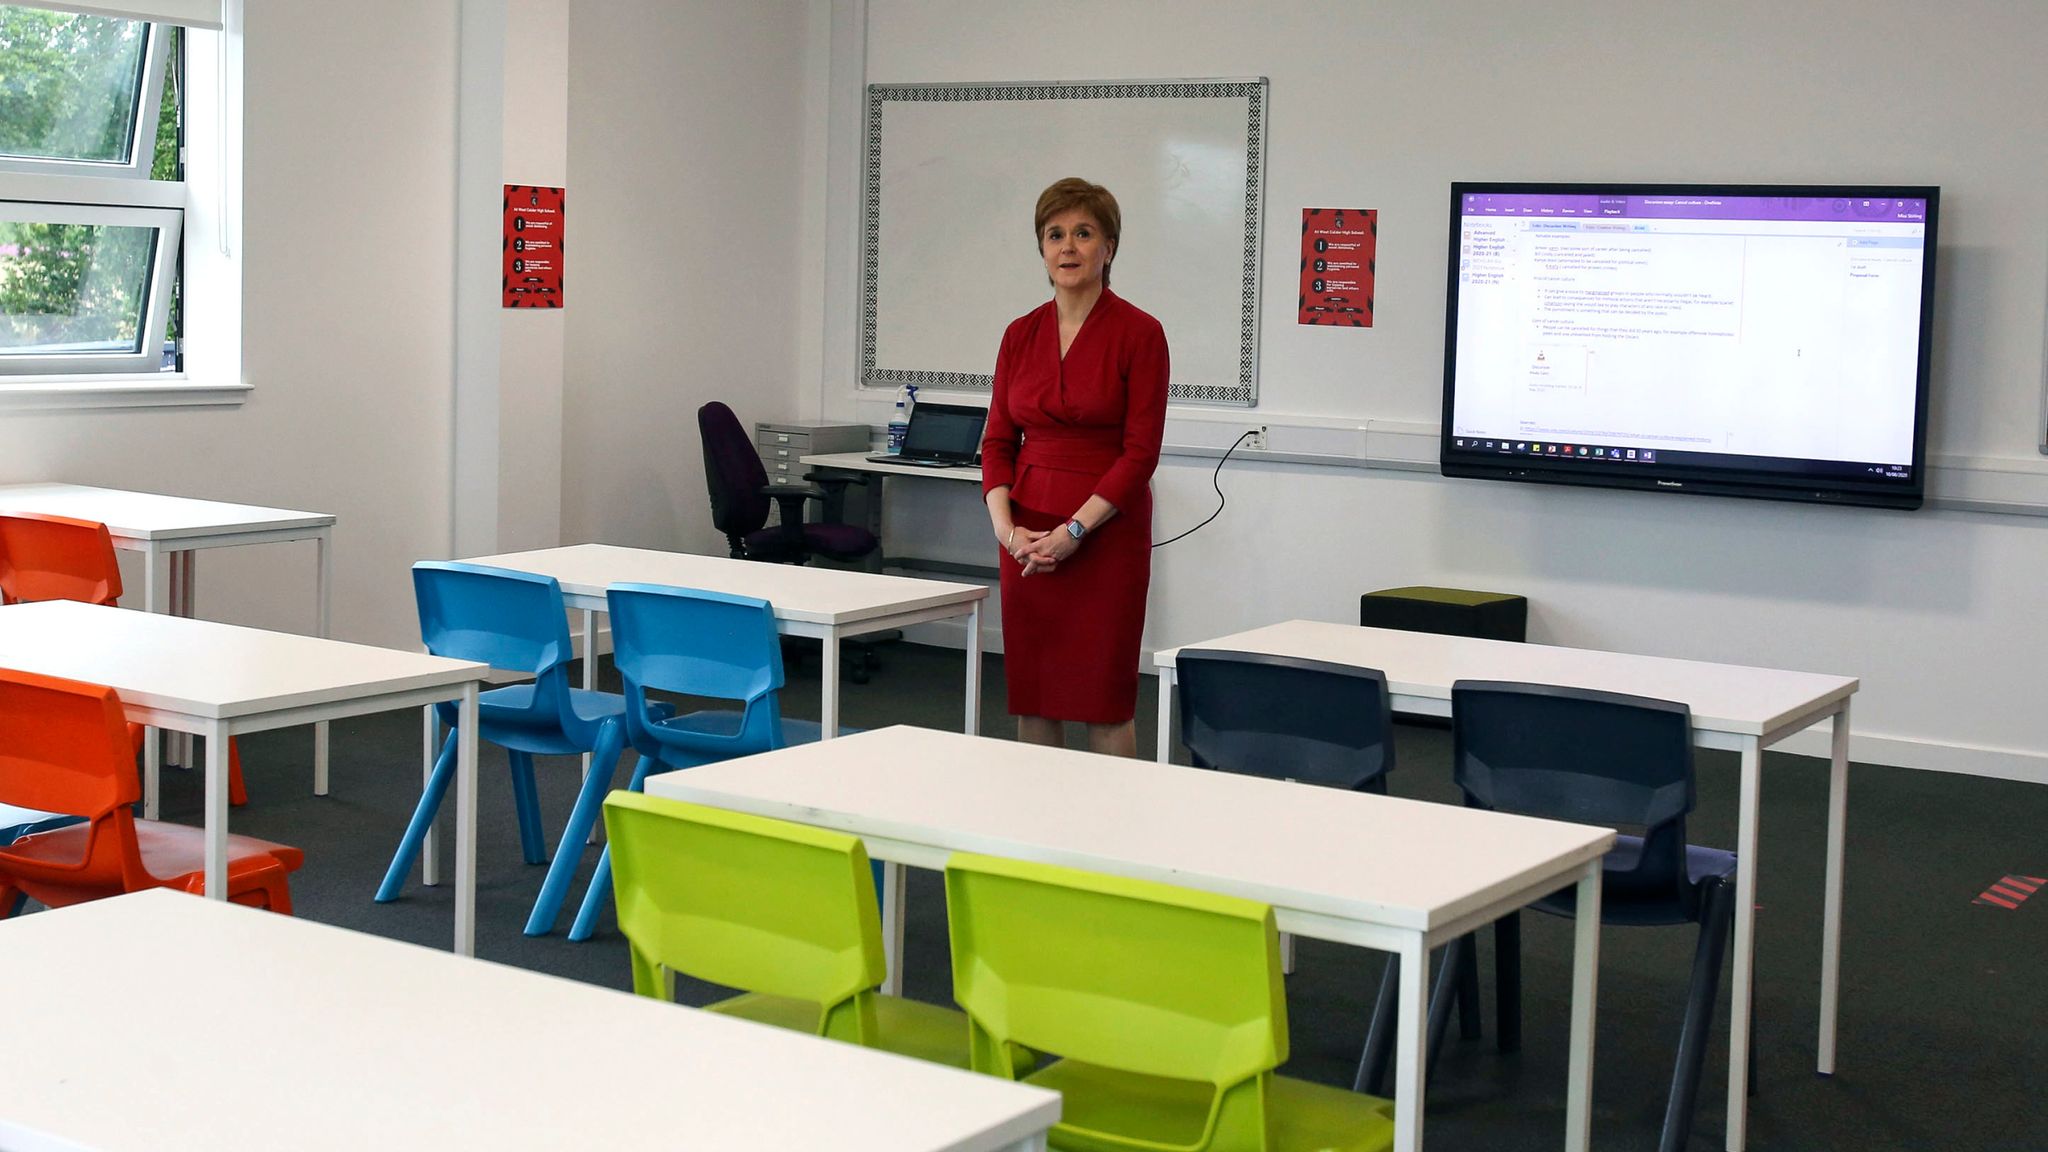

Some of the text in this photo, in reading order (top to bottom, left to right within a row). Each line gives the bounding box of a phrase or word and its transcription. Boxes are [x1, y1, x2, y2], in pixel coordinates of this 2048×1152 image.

[517, 219, 522, 229] 1
[516, 240, 522, 250] 2
[1319, 241, 1322, 251] 1
[516, 261, 521, 271] 3
[1317, 261, 1323, 271] 2
[1315, 281, 1321, 291] 3
